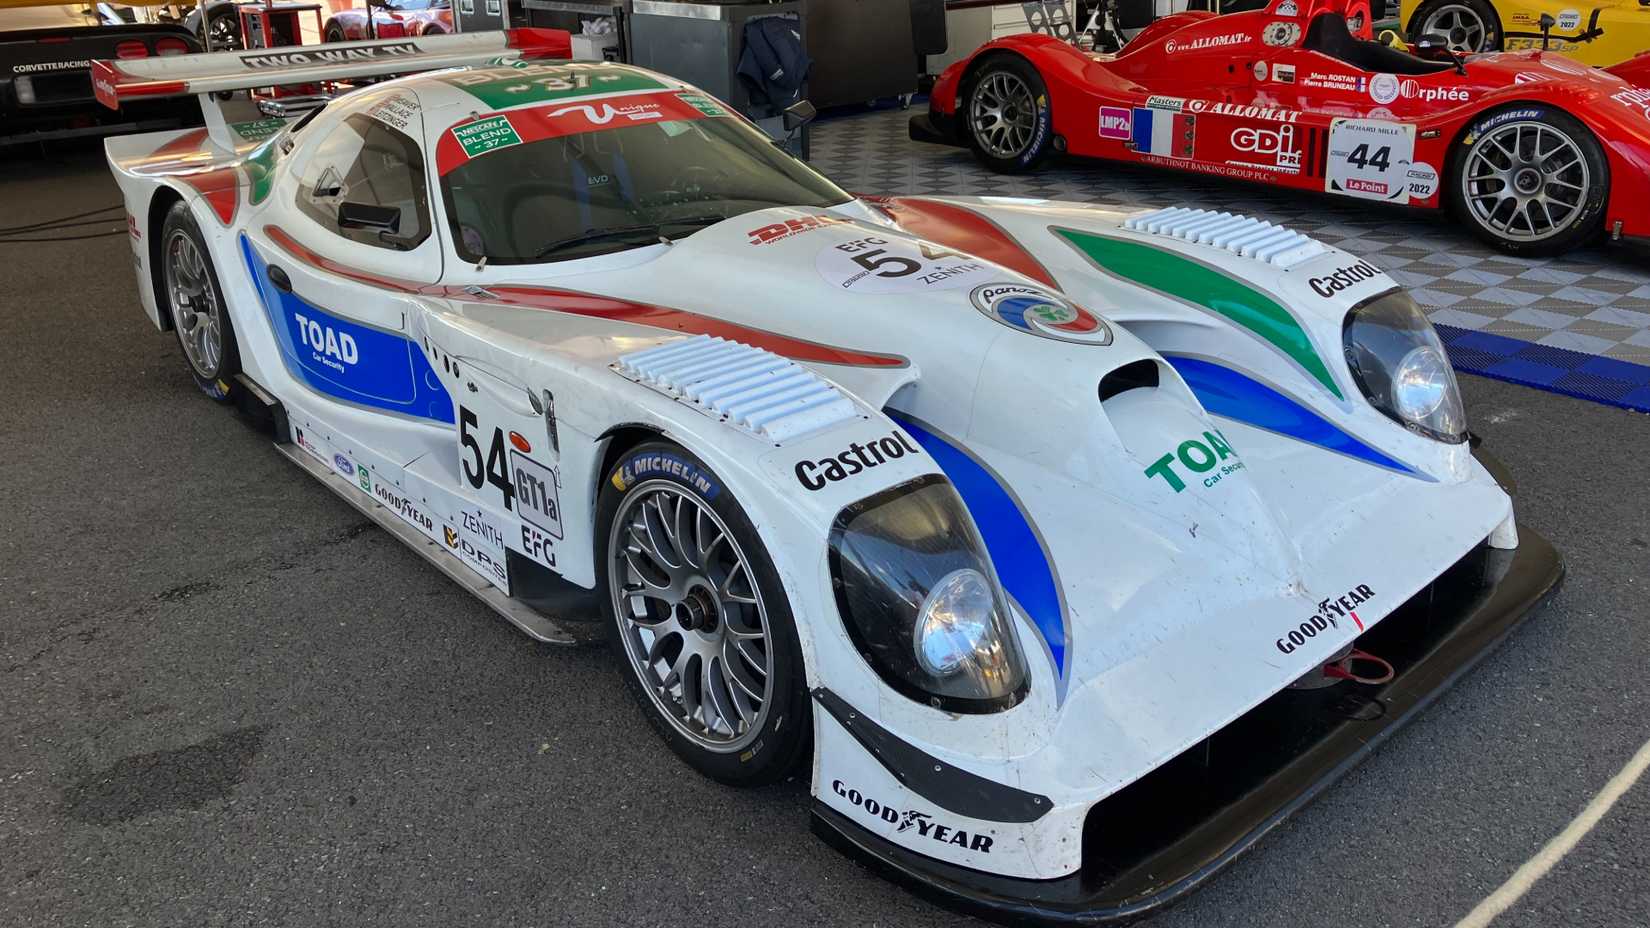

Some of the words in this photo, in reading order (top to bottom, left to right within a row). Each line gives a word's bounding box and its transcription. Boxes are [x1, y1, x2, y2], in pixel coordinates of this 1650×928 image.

[244, 54, 311, 68] TWO
[314, 48, 374, 62] WAY
[382, 44, 417, 56] TV
[1210, 102, 1302, 123] ALLOMAT
[1480, 110, 1539, 132] MICHELIN
[463, 127, 511, 146] BLEND
[483, 138, 499, 148] 37
[1347, 143, 1391, 172] 44
[1191, 162, 1225, 175] BANKING
[1226, 167, 1254, 179] GROUP
[1254, 170, 1269, 181] PLC
[1349, 180, 1360, 189] Le
[1360, 181, 1385, 193] Point
[1409, 182, 1431, 195] 2022
[835, 236, 889, 253] EFG
[916, 263, 986, 286] ZENITH
[1308, 259, 1382, 299] Castrol
[294, 312, 359, 366] TOAD
[459, 404, 516, 512] 54
[794, 430, 919, 492] Castrol
[1144, 428, 1238, 493] TOA
[634, 455, 712, 495] MICHELIN
[1203, 472, 1223, 488] Car
[461, 510, 504, 550] ZENITH
[521, 524, 556, 567] EFG
[1276, 583, 1376, 654] GOODYEAR
[832, 779, 995, 854] GOODYEAR
